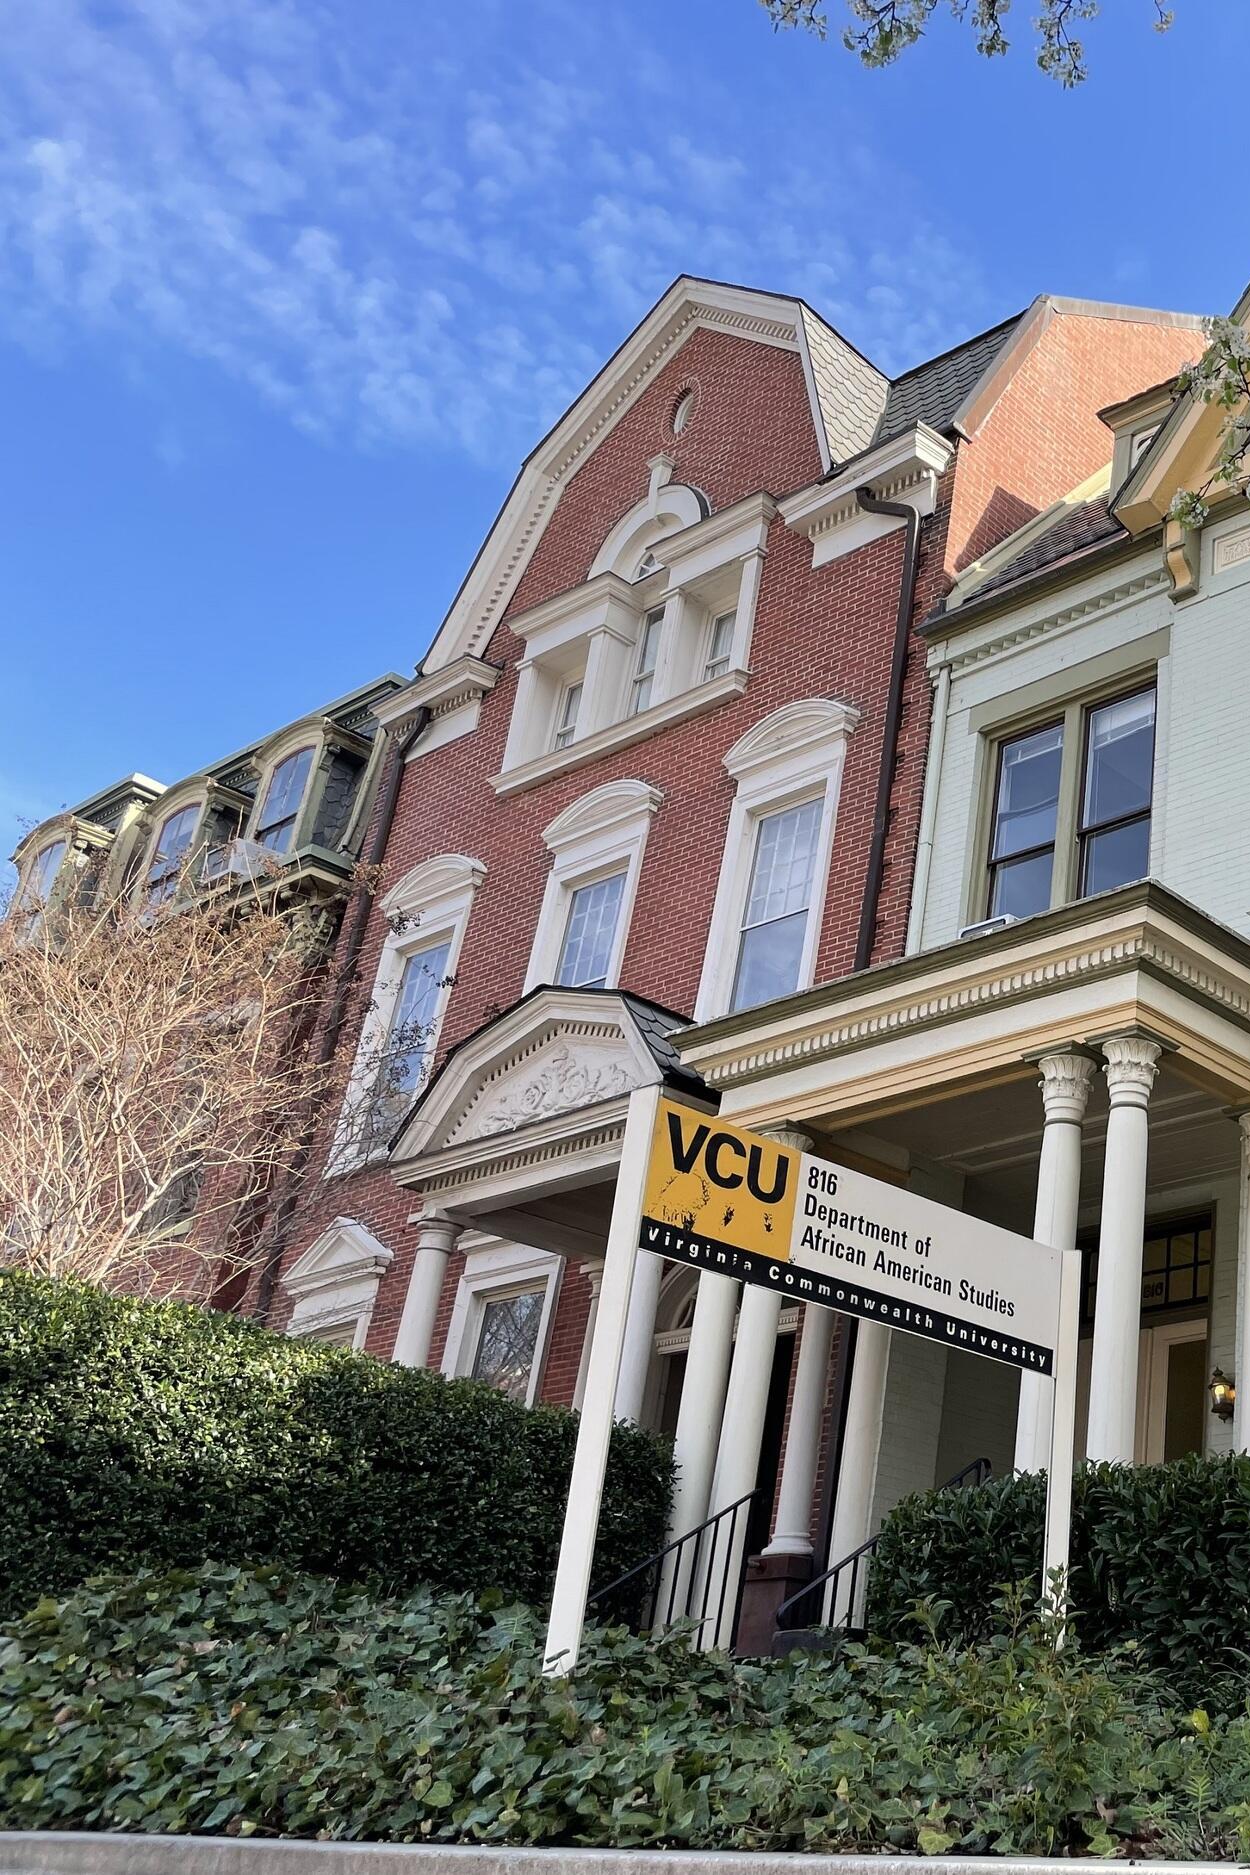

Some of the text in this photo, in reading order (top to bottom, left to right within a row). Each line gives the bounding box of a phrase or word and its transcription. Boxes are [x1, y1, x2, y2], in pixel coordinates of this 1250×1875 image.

[667, 1111, 790, 1204] VCU
[808, 1166, 838, 1196] 816
[800, 1225, 1015, 1317] African American Studies
[804, 1193, 932, 1258] Department of
[648, 1226, 1046, 1367] Virginia Commonwealth University
